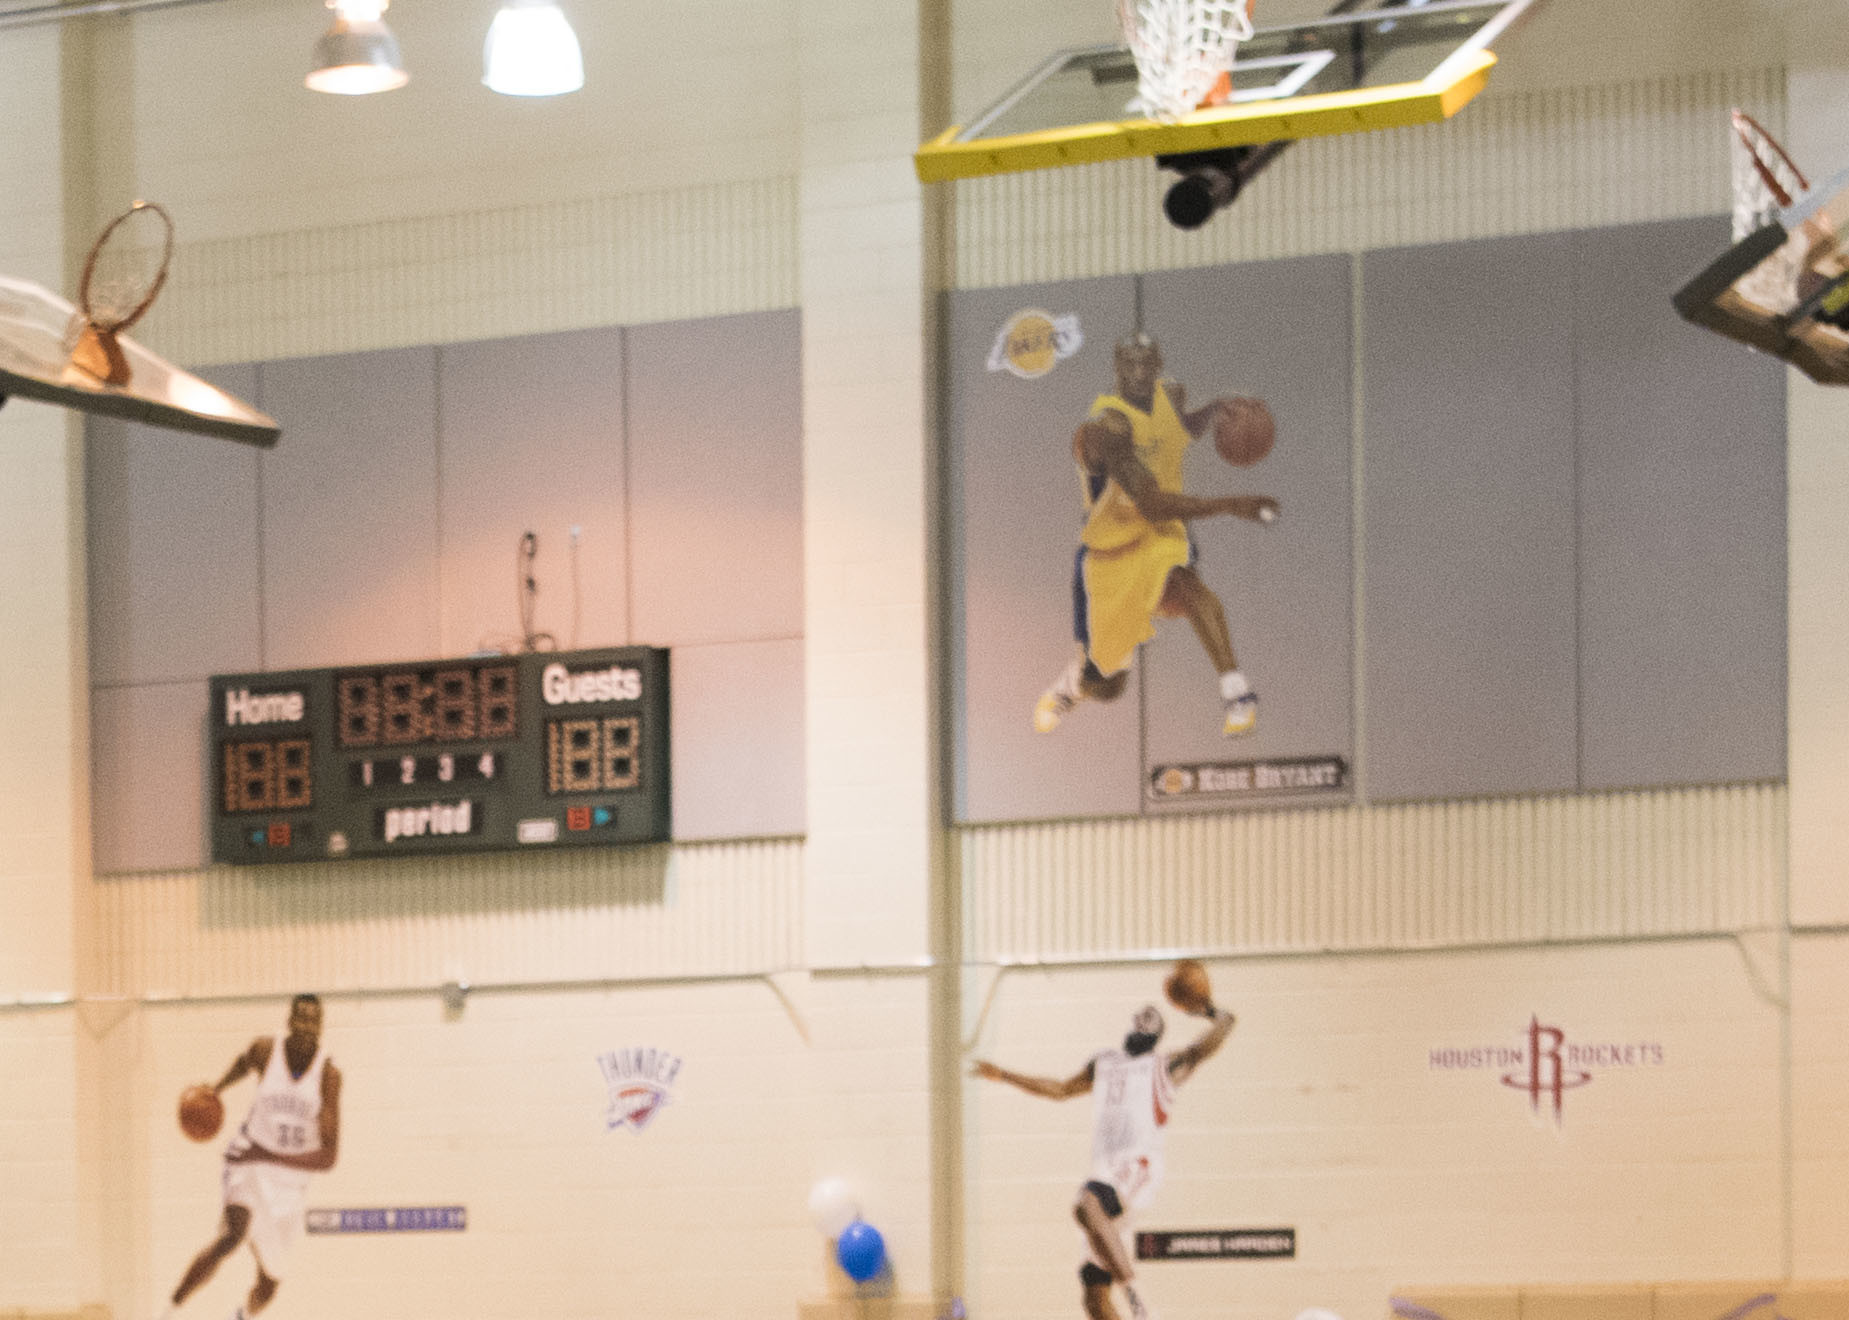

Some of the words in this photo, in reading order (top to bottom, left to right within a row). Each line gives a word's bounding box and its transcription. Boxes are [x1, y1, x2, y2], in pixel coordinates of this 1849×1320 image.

[542, 664, 642, 706] Guests
[225, 688, 305, 726] Home
[360, 760, 374, 787] 1
[400, 756, 416, 784] 2
[438, 754, 454, 782] 3
[478, 752, 495, 779] 4
[385, 801, 472, 843] period
[1428, 1047, 1523, 1069] HOUSTON
[1567, 1043, 1664, 1066] ROCKETS
